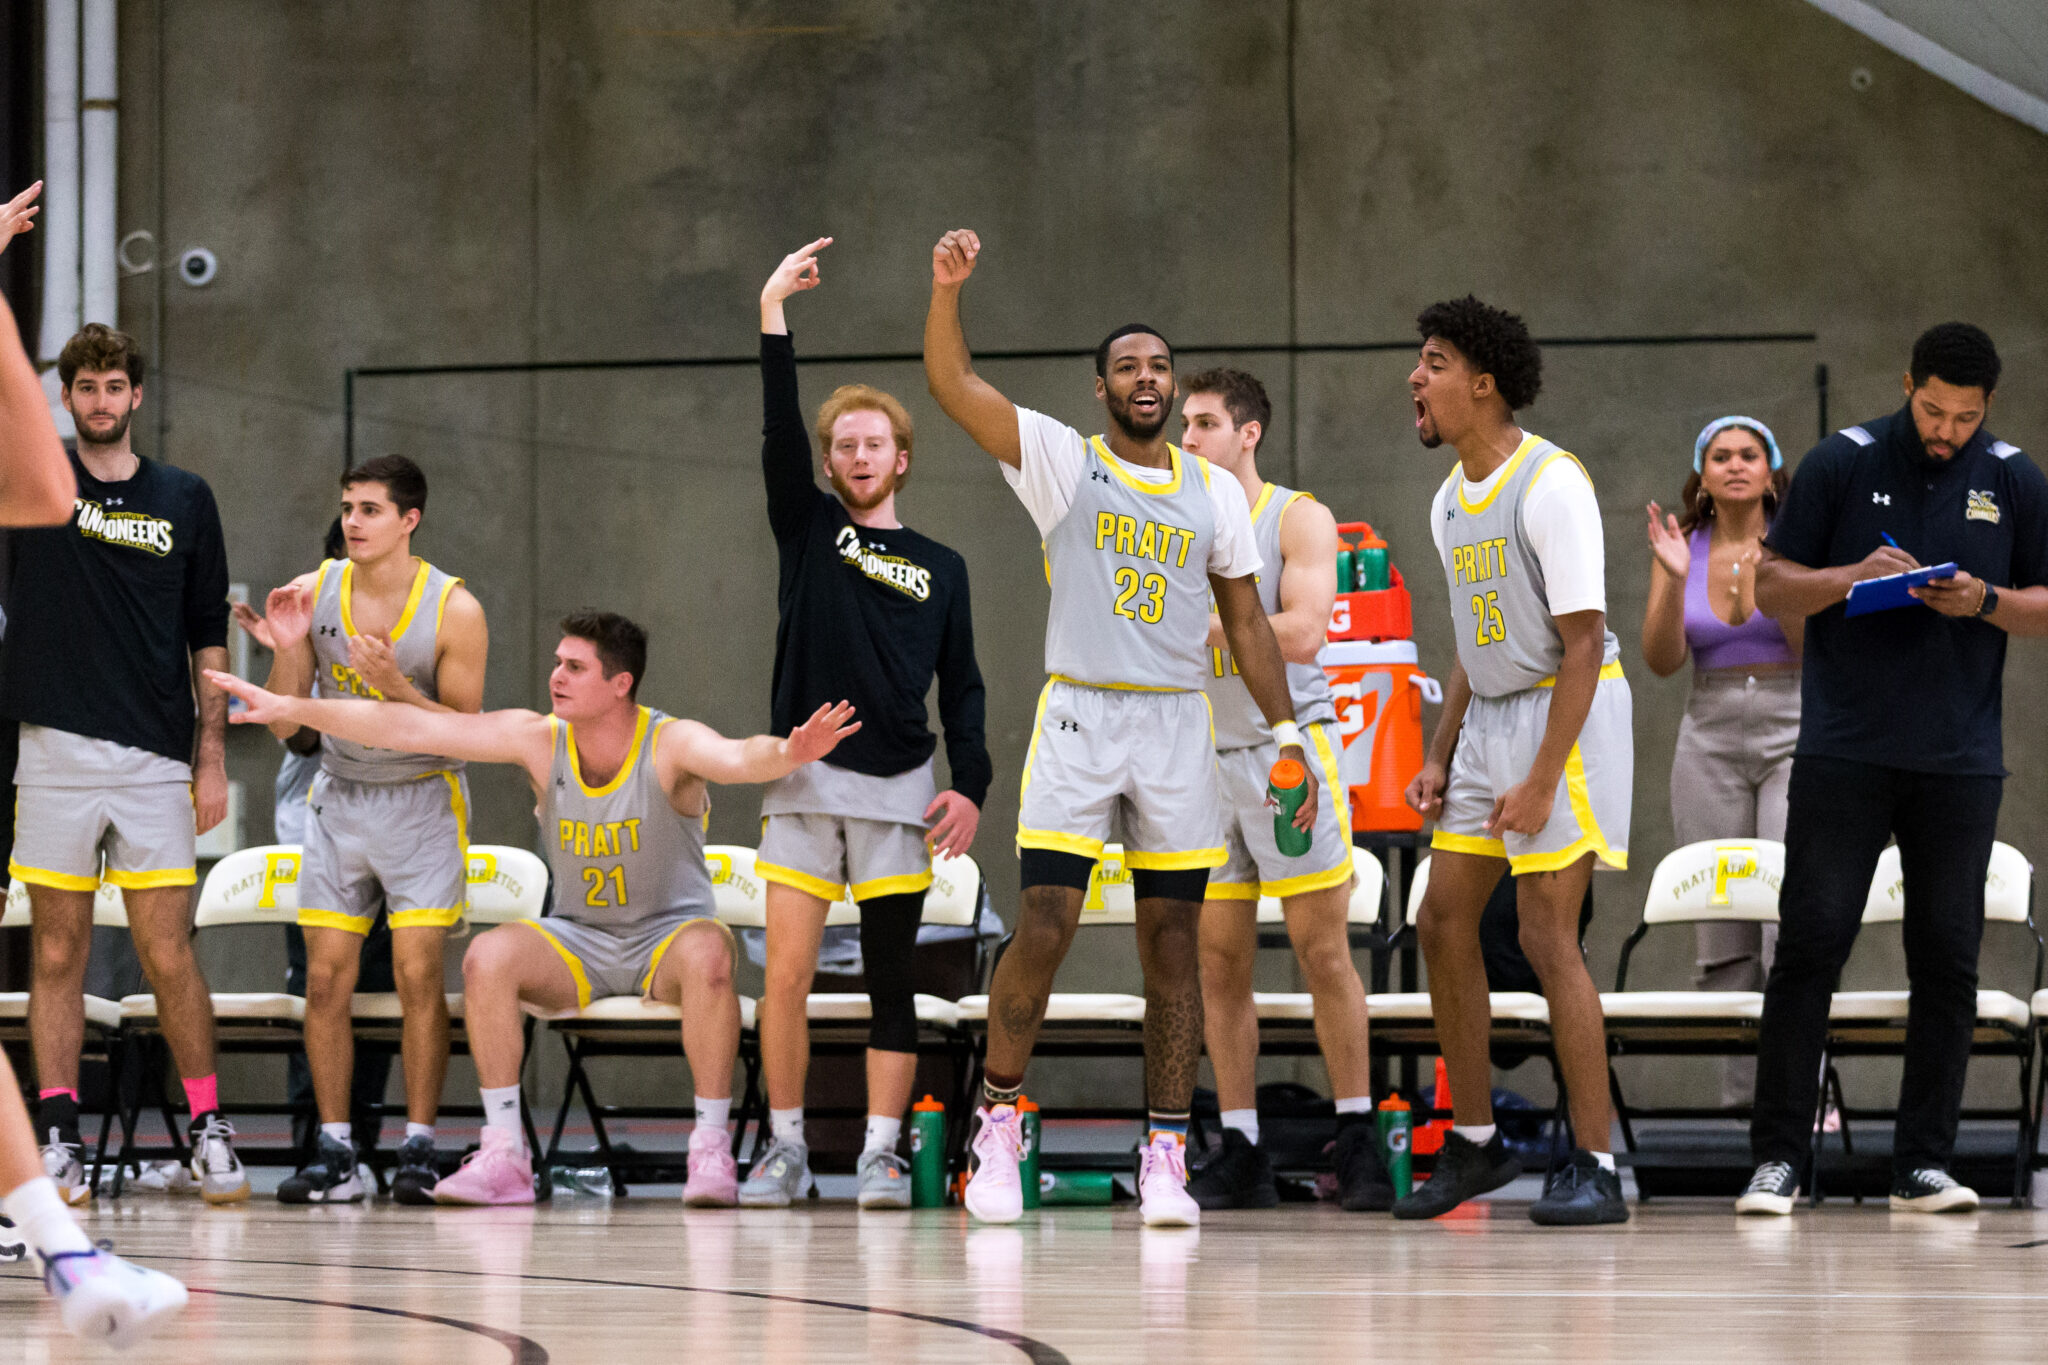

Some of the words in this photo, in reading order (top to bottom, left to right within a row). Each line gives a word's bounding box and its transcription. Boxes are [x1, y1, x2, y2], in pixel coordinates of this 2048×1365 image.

[73, 499, 174, 552] ANONEERS
[1095, 511, 1196, 569] PRATT
[836, 526, 931, 600] CAONEERS
[1452, 537, 1507, 587] PRATT
[1113, 567, 1167, 624] 23
[1471, 590, 1506, 647] 25
[559, 818, 641, 857] PRATT
[223, 870, 265, 903] PRATT
[464, 868, 524, 898] THLETICS
[582, 864, 628, 907] 21
[710, 870, 758, 900] HLETICS
[1673, 865, 1715, 900] PRATT
[1710, 846, 1757, 905] P
[1387, 1127, 1407, 1152] G
